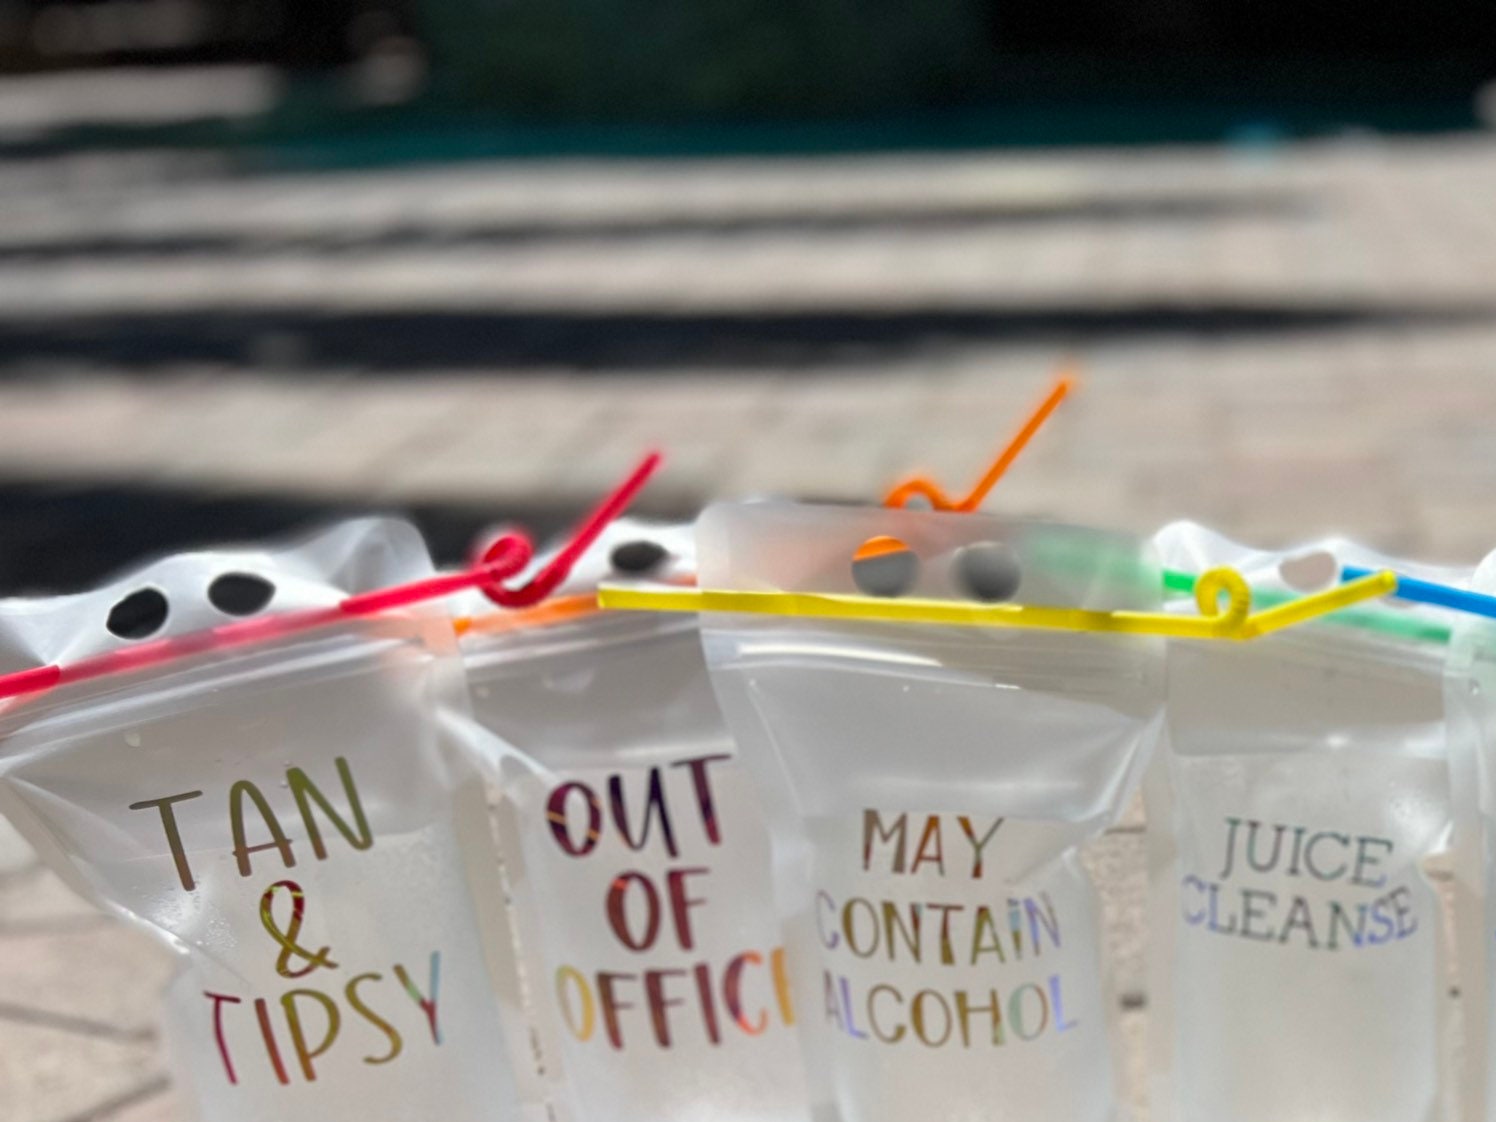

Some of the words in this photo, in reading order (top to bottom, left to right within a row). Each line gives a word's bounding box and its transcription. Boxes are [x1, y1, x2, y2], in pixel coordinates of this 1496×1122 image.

[129, 756, 373, 892] TAN
[546, 754, 732, 859] OUT
[862, 808, 1004, 880] MAY
[1220, 816, 1394, 889] JUICE
[259, 879, 339, 979] &
[606, 867, 711, 954] OF
[1181, 873, 1418, 950] CLEANSE
[203, 950, 443, 1086] TIPSY
[822, 969, 1080, 1048] ALCOHOL
